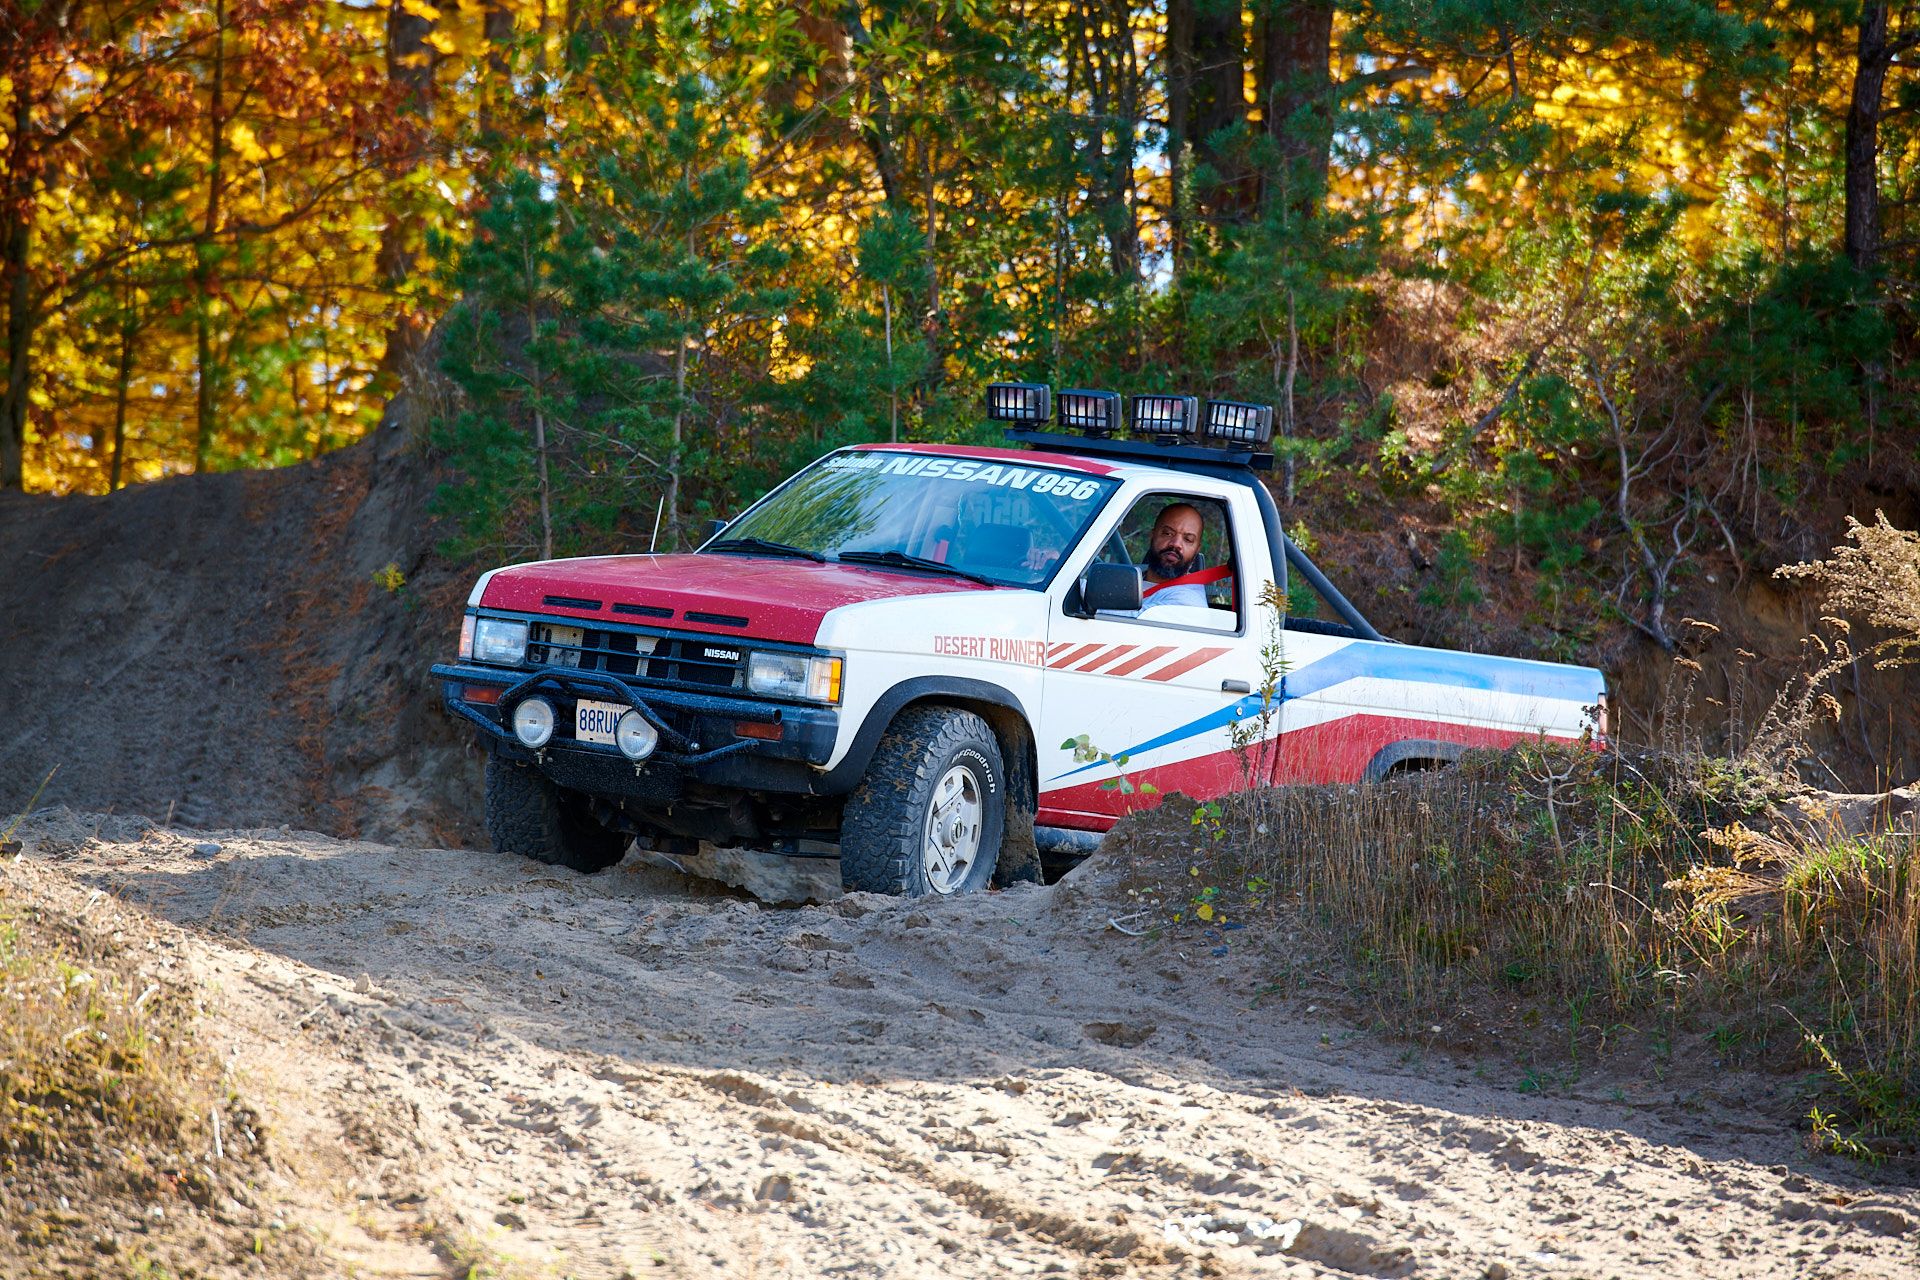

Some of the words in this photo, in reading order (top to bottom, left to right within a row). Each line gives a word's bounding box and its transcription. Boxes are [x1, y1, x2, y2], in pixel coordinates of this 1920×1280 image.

[878, 456, 1042, 490] NISSAN
[1031, 473, 1101, 501] 956
[704, 647, 740, 661] NISSAN
[934, 635, 986, 657] DESERT
[989, 637, 1046, 667] RUNNER
